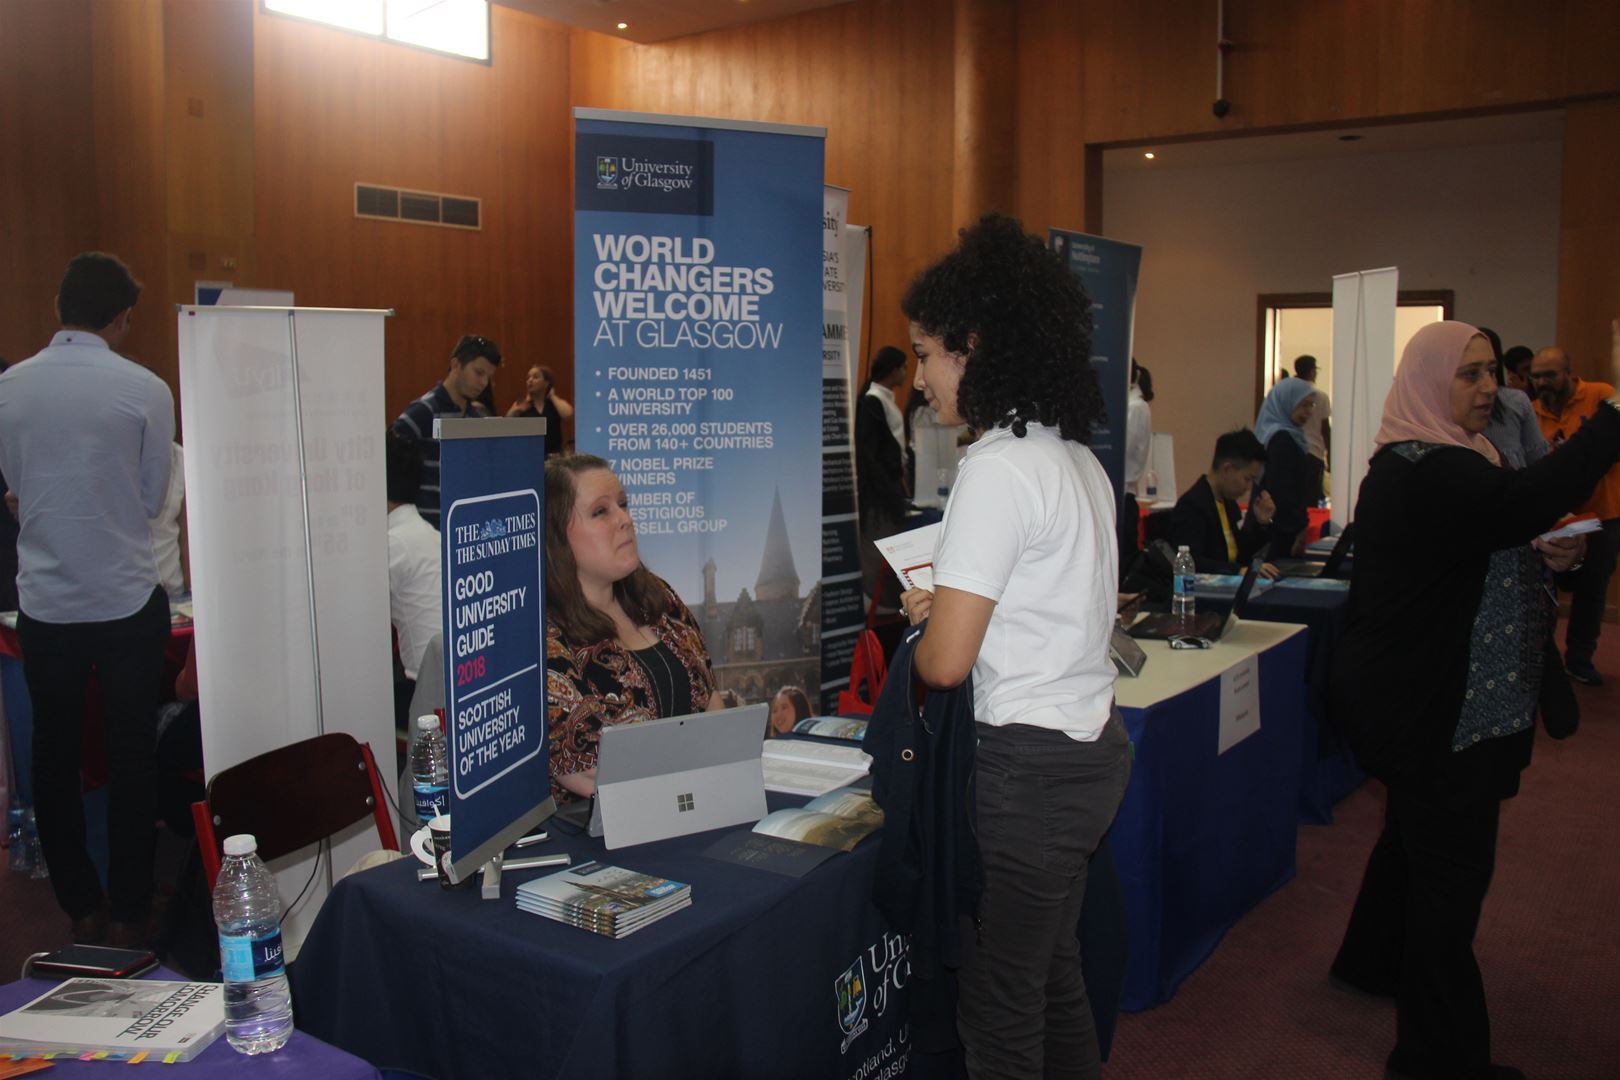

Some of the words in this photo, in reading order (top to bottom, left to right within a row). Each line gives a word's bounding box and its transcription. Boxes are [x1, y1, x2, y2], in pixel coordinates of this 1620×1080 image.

[621, 157, 693, 177] University
[621, 173, 635, 190] of
[634, 172, 693, 192] Glasgow
[593, 234, 715, 264] WORLD
[593, 262, 774, 295] CHANGERS
[593, 291, 760, 321] WELCOME
[593, 320, 629, 347] AT
[636, 320, 783, 349] GLASGOW
[608, 367, 679, 380] FOUNDED
[682, 368, 712, 380] 1451
[608, 388, 618, 400] A
[622, 388, 675, 400] WORLD
[678, 388, 707, 400] TOP
[712, 388, 733, 401] 100
[608, 402, 692, 415] UNIVERSITY
[608, 423, 648, 436] OVER
[651, 423, 696, 437] 26,000
[700, 422, 773, 435] STUDENTS
[608, 438, 650, 450] FROM
[655, 438, 688, 450] 140+
[693, 436, 773, 449] COUNTRIES
[609, 459, 617, 470] 7
[621, 458, 670, 471] NOBEL
[673, 457, 714, 470] PRIZE
[629, 505, 705, 520] ESTIGIOUS
[676, 492, 696, 504] OF
[455, 523, 480, 545] THE
[504, 512, 536, 534] TIMES
[677, 519, 728, 533] GROUP
[455, 544, 478, 565] THE
[476, 537, 511, 560] SUNDAY
[510, 531, 537, 551] TIMES
[455, 570, 494, 601] GOOD
[456, 586, 527, 629] UNIVERSITY
[456, 624, 495, 657] GUIDE
[457, 655, 486, 687] 2018
[458, 688, 512, 730] SCOTTISH
[459, 705, 520, 753] UNIVERSITY
[460, 751, 475, 776] OF
[476, 740, 499, 766] THE
[499, 725, 526, 753] YEAR
[171, 984, 219, 1019] CHANGE
[873, 963, 892, 1017] of
[116, 984, 197, 1039] TOMORROW
[135, 1018, 174, 1041] OUR
